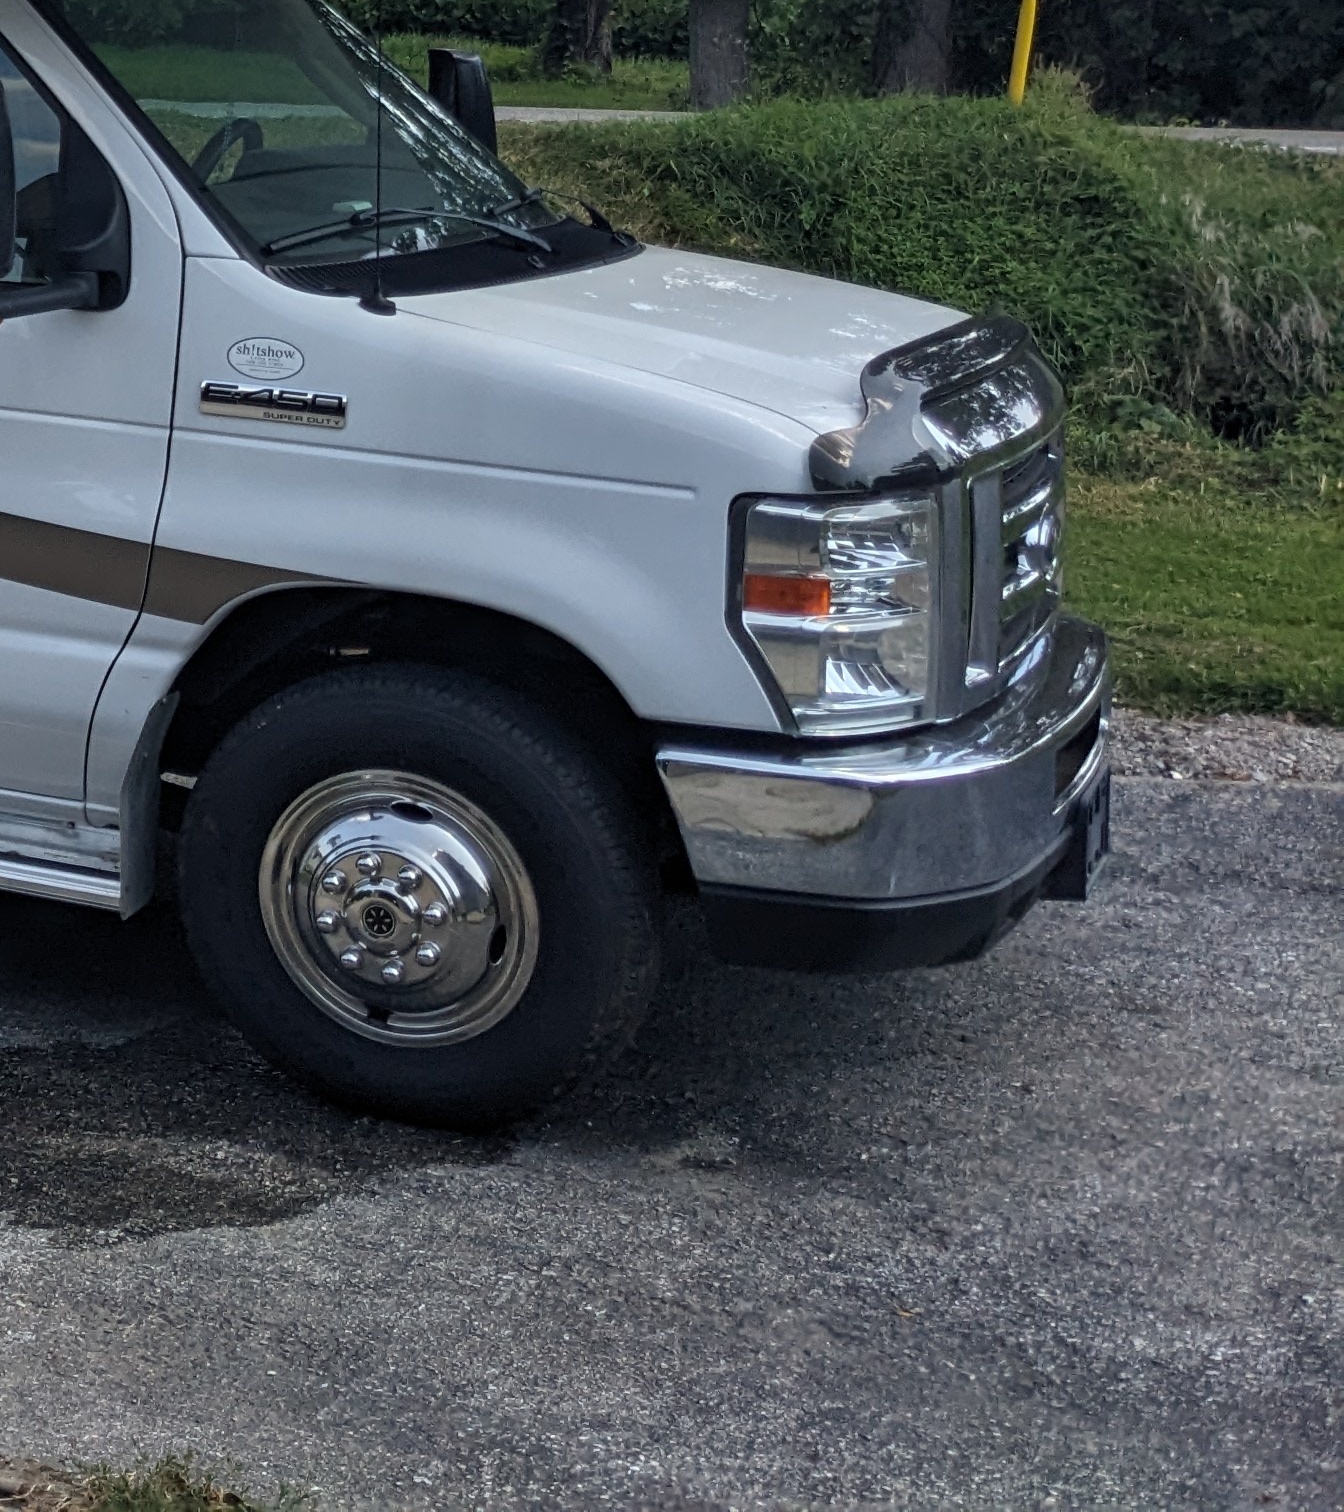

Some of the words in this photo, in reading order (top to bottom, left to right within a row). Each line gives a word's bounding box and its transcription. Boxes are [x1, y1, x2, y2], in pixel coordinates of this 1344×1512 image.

[235, 343, 295, 359] sh!tshow
[262, 411, 304, 423] SUPER
[306, 416, 342, 426] DUTY
